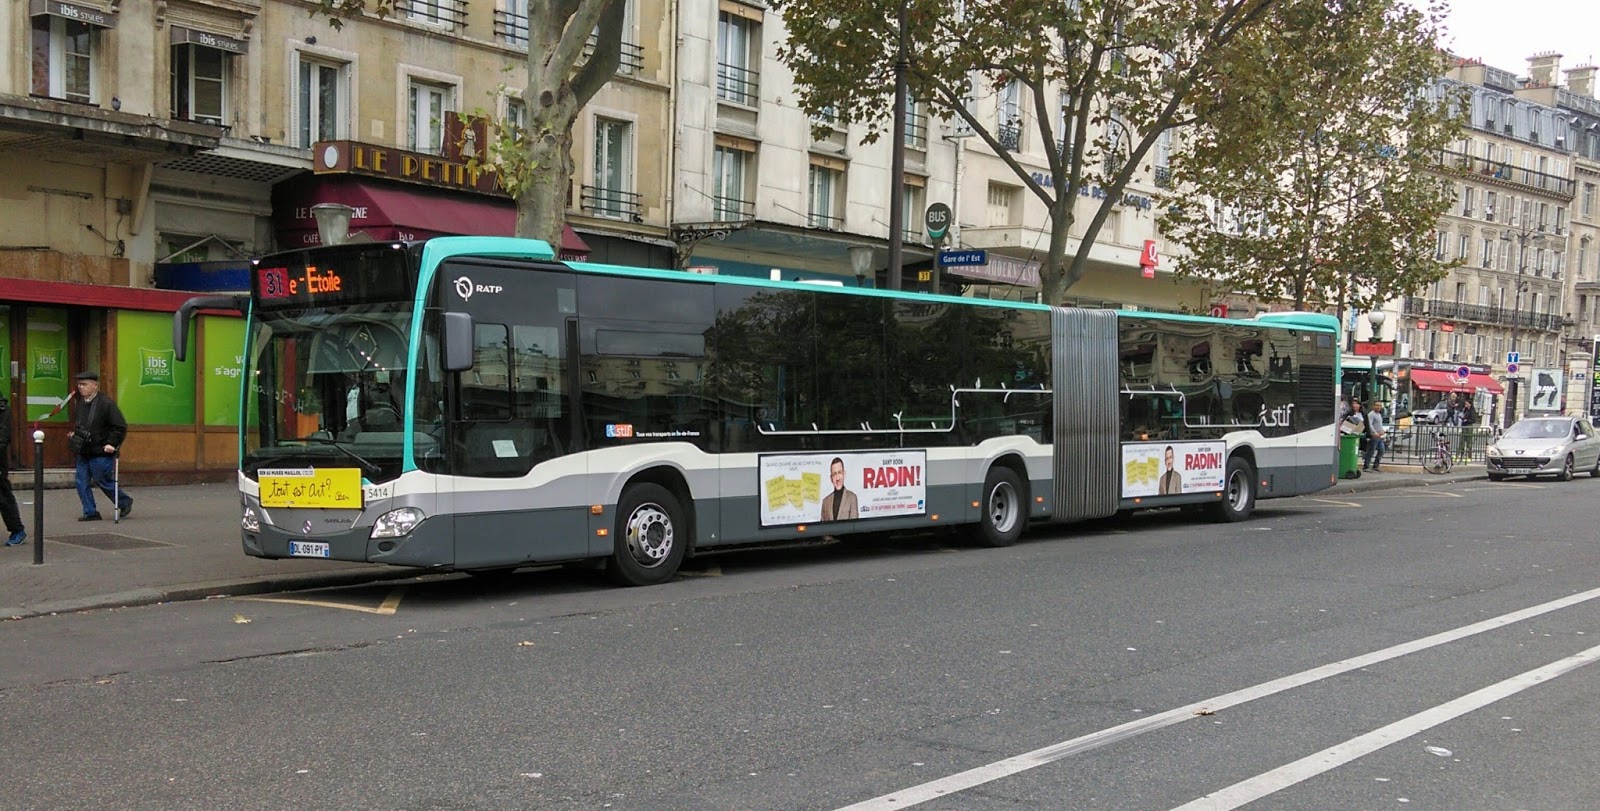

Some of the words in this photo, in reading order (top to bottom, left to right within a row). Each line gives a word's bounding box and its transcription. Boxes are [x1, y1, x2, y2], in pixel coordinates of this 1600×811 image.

[60, 4, 78, 17] ibis
[200, 33, 215, 46] ibis
[352, 145, 388, 172] LE
[401, 154, 479, 187] PETIT
[296, 208, 307, 219] LE
[928, 210, 946, 223] BUS
[398, 231, 415, 242] BAR
[289, 279, 297, 294] e
[306, 266, 341, 293] Etoile
[920, 272, 929, 280] 31
[265, 271, 282, 295] 31
[476, 284, 503, 295] RATP
[40, 354, 56, 364] ibis
[148, 356, 167, 368] ibis
[1271, 403, 1294, 427] stif
[616, 425, 632, 437] stif
[1184, 453, 1222, 470] RADIN!
[863, 466, 921, 489] RADIN!
[269, 479, 290, 498] tout
[368, 487, 388, 499] 5414
